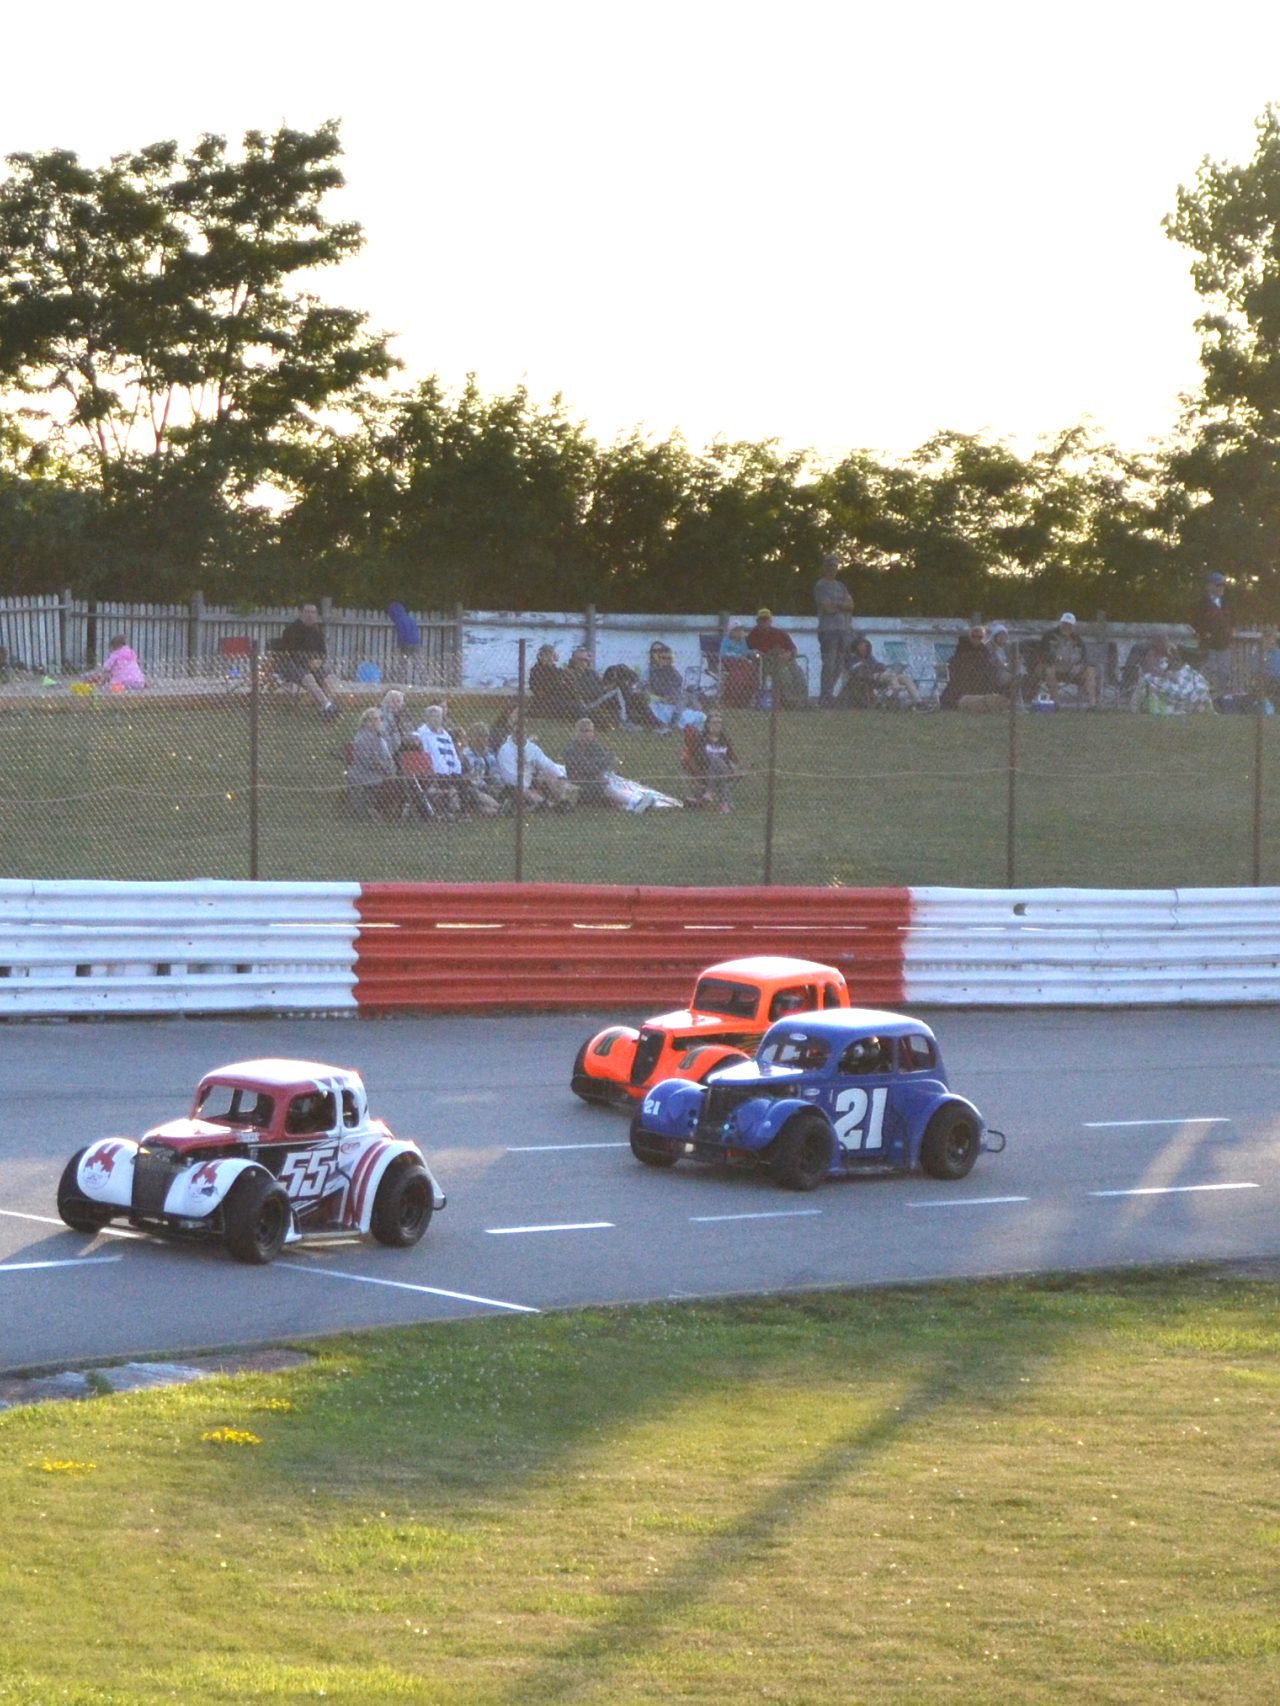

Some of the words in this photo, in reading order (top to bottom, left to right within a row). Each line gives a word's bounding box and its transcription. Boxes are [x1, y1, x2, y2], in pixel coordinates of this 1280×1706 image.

[643, 1099, 661, 1115] 21
[834, 1087, 888, 1150] 21
[282, 1149, 334, 1197] 55
